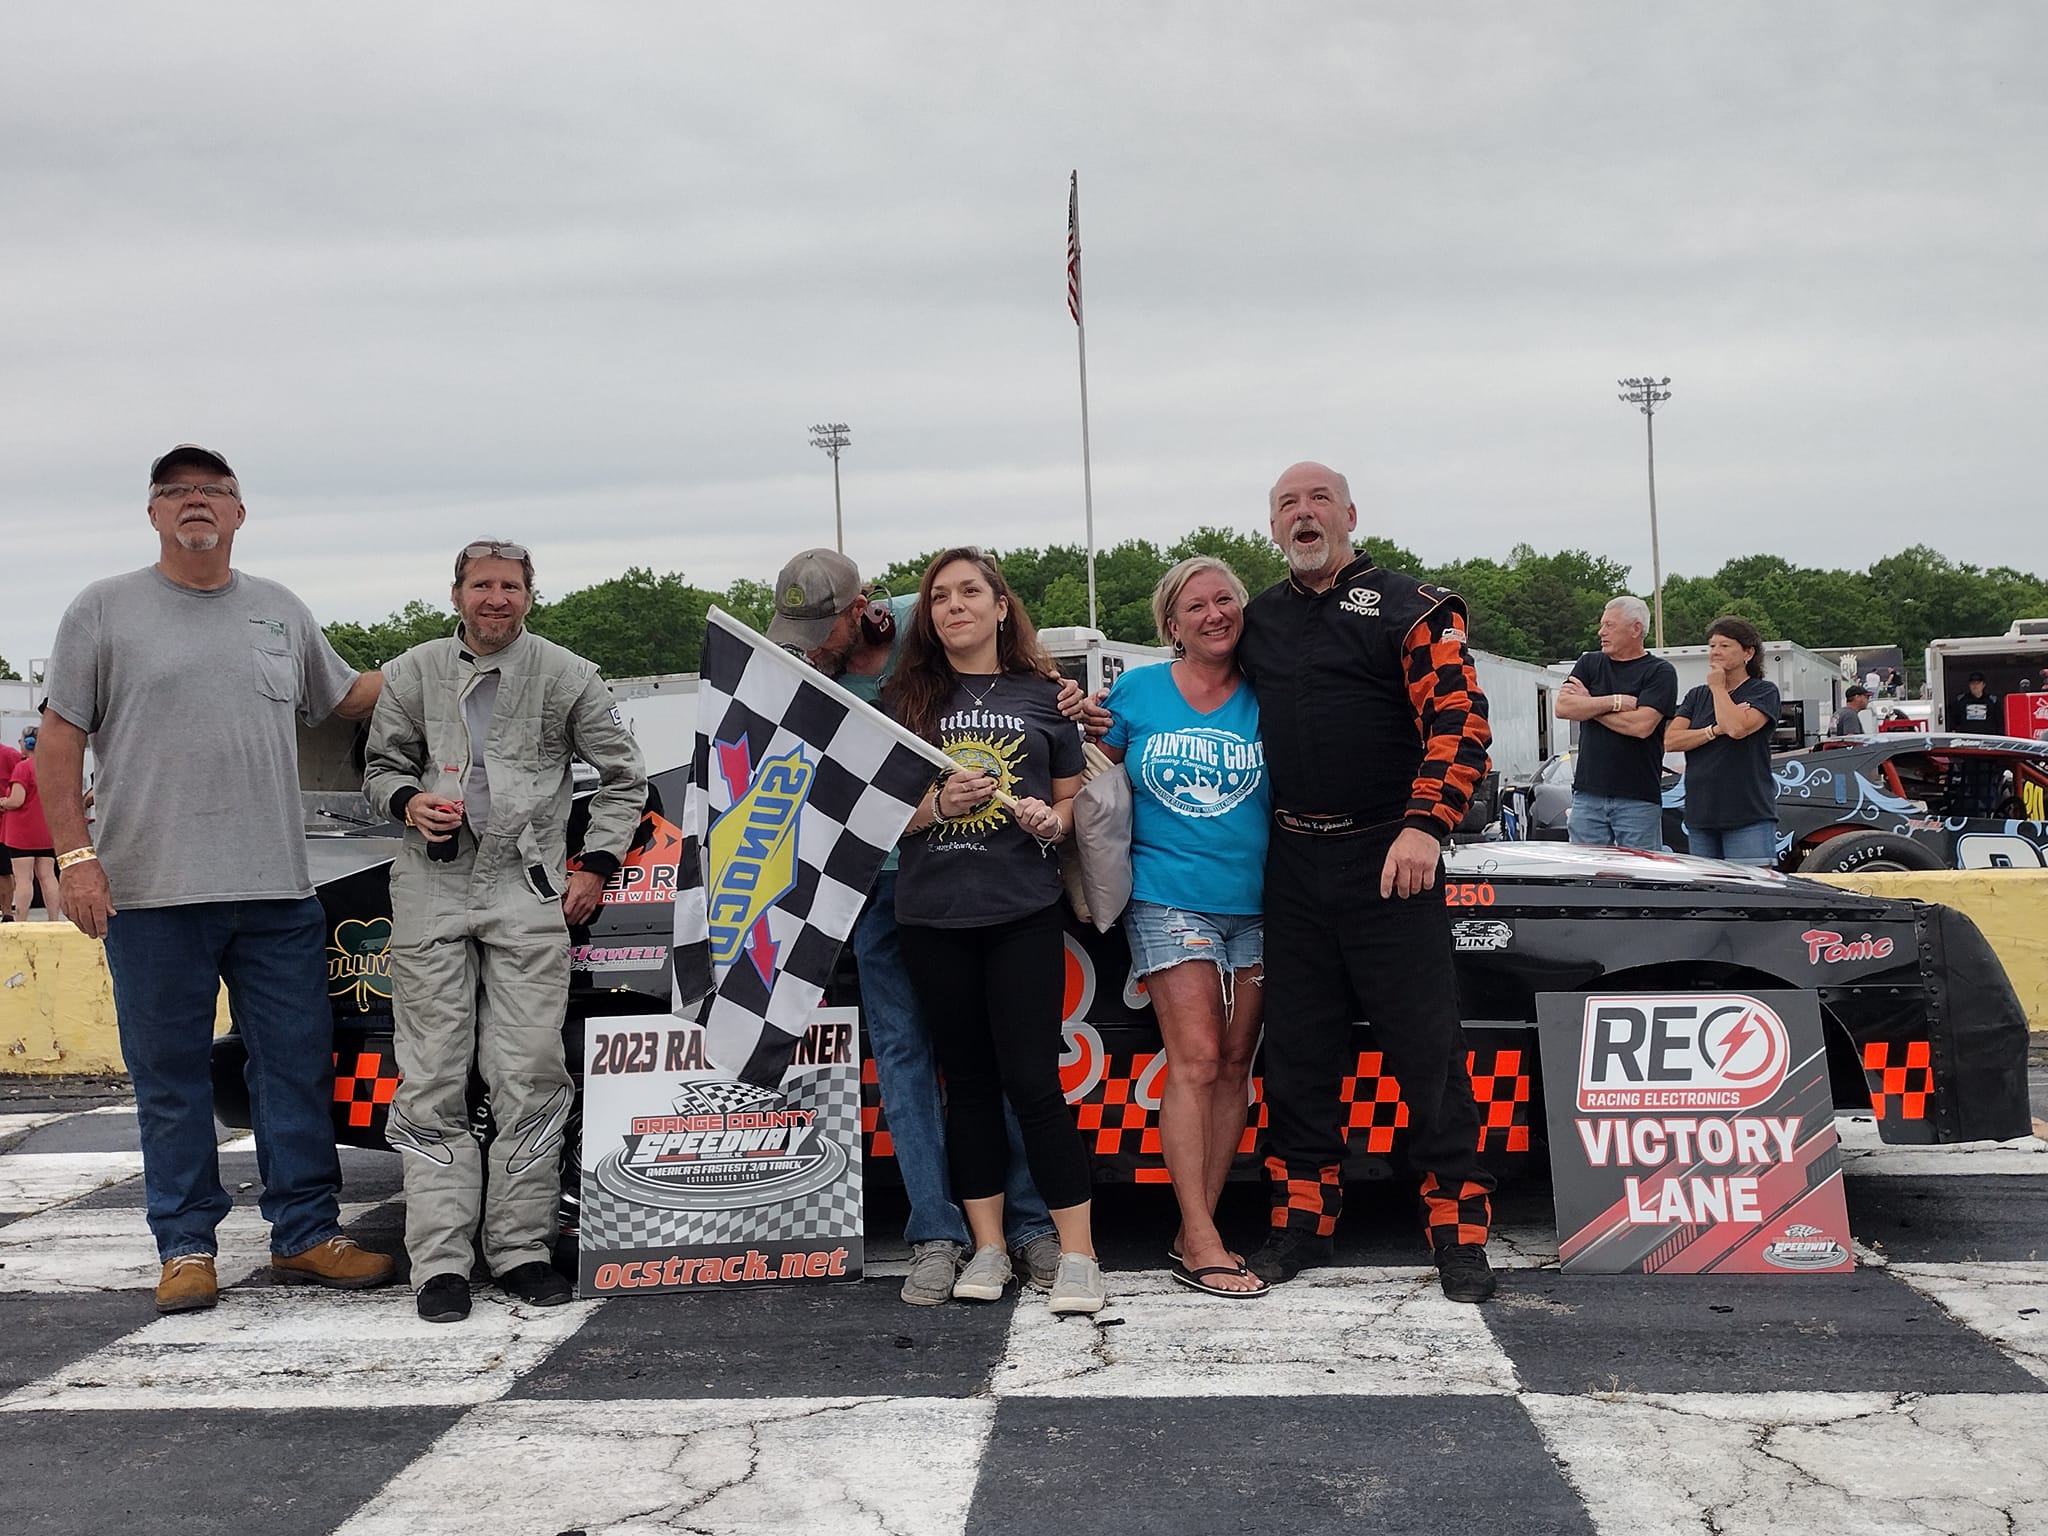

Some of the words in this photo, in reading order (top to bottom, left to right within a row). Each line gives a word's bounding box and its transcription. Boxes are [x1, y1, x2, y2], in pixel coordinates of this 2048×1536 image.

[1340, 601, 1380, 617] TOYOTA
[940, 709, 1025, 732] ublime
[1141, 732, 1219, 767] FAINTING
[1223, 741, 1265, 770] GOAT
[602, 866, 646, 891] EP
[650, 863, 679, 890] R
[602, 890, 678, 903] REWING
[1445, 883, 1495, 906] 250
[569, 944, 668, 961] HOWELL
[1457, 938, 1496, 947] LINK
[1801, 929, 1894, 965] Panic
[327, 953, 392, 981] ULLIV
[591, 1031, 659, 1075] 2023
[1586, 1092, 1641, 1107] RACING
[1644, 1091, 1741, 1107] ELECTRONICS
[633, 1113, 724, 1135] ORANGE
[727, 1109, 817, 1130] COUNTY
[630, 1127, 814, 1164] SPEEDWAY
[1575, 1116, 1803, 1167] VICTORY
[645, 1164, 700, 1178] AMERICA'S
[701, 1162, 748, 1175] FASTEST
[748, 1161, 768, 1173] 3/8
[769, 1160, 803, 1171] TRACK
[1624, 1176, 1763, 1225] LANE
[1772, 1241, 1837, 1255] SPEEDWAY
[594, 1247, 849, 1290] ocstrack.net
